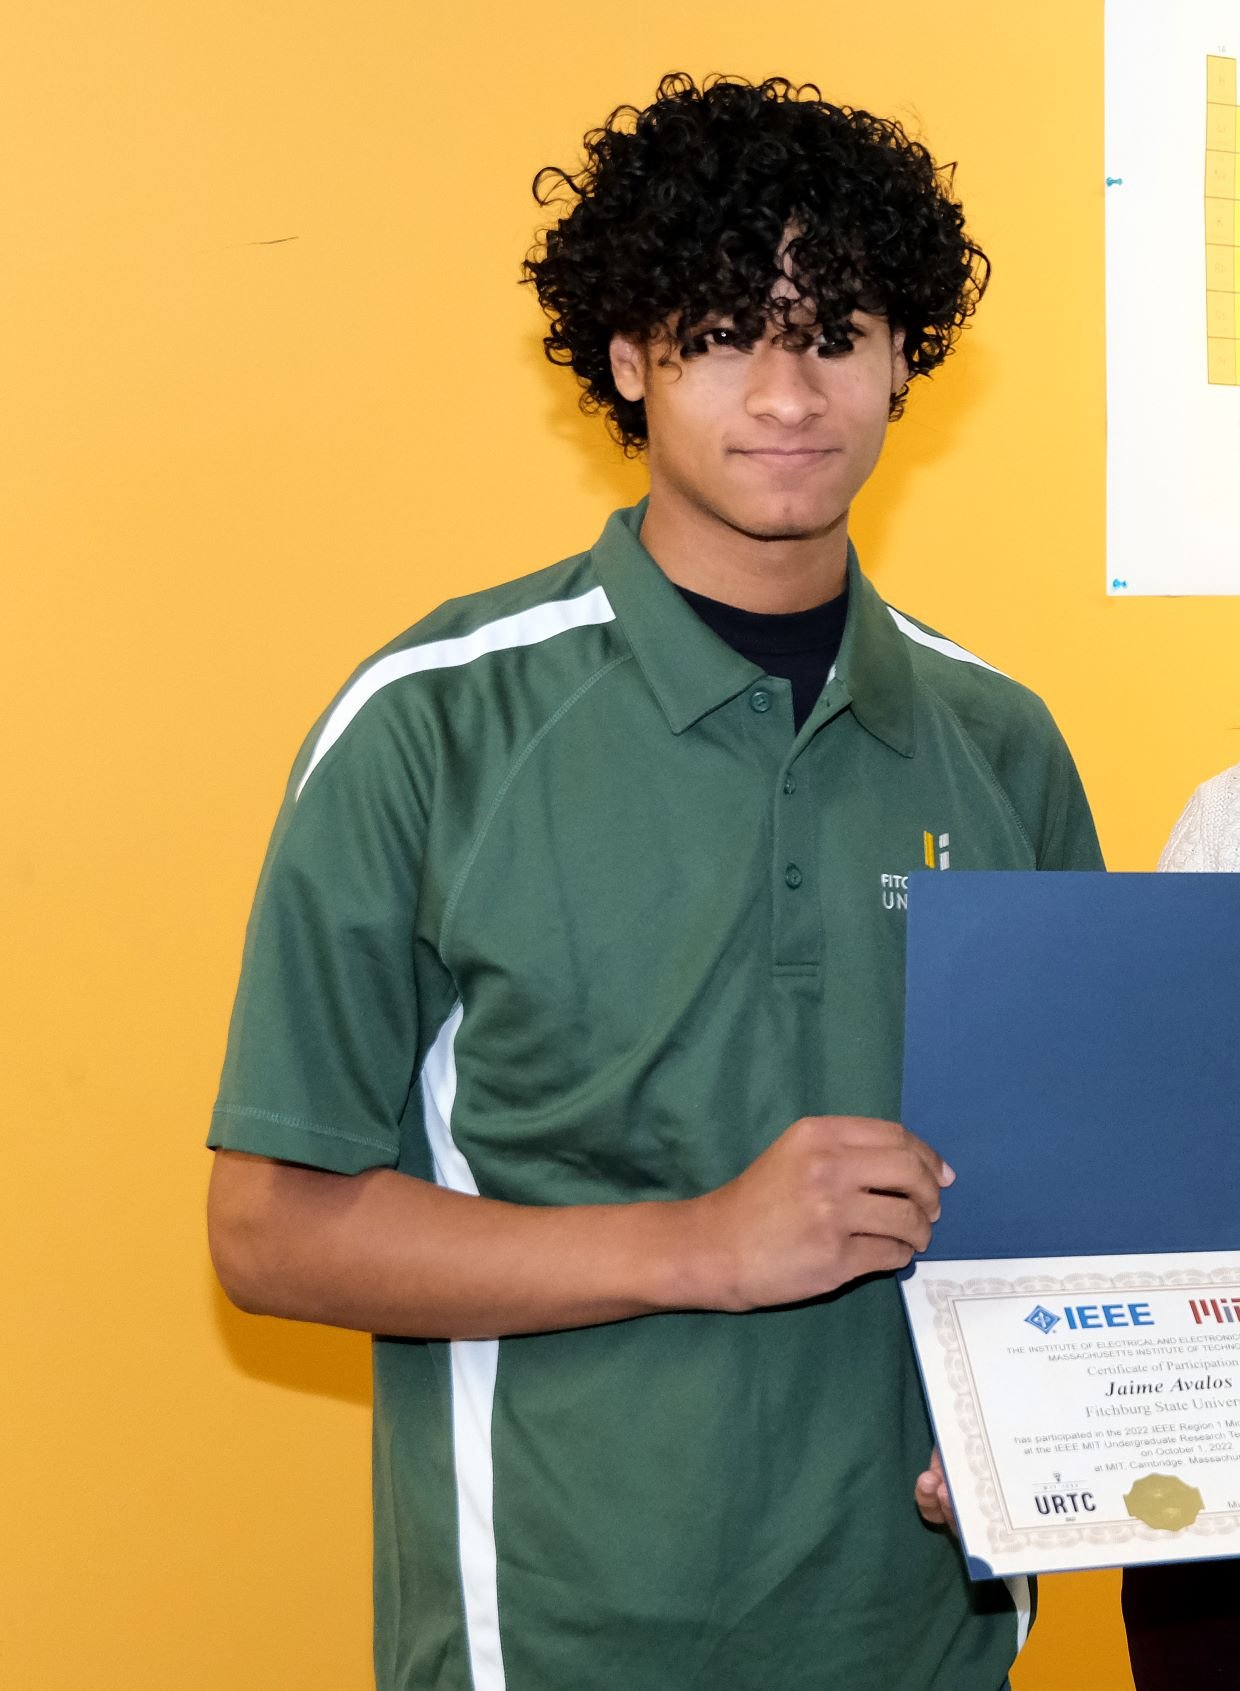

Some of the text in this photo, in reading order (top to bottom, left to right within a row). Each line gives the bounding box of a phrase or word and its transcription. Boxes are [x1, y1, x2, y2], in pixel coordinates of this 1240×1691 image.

[1064, 1303, 1155, 1330] IEEE
[1007, 1346, 1024, 1354] THE
[1028, 1343, 1076, 1353] INSTITUTE
[1096, 1339, 1153, 1349] ELECTRICAL
[1156, 1337, 1177, 1345] AND
[1048, 1349, 1133, 1361] MASSACHUSETTS
[1136, 1346, 1184, 1356] INSTITUTE
[1087, 1358, 1239, 1376] Certificate of Participation
[1106, 1376, 1232, 1396] Jaime Avalos
[1086, 1403, 1151, 1417] Fitchburg
[1155, 1401, 1189, 1412] State
[1035, 1430, 1092, 1443] participated
[1106, 1428, 1122, 1436] the
[1125, 1426, 1148, 1435] 2022
[1151, 1424, 1176, 1433] IEEE
[1179, 1422, 1214, 1431] Region
[1217, 1420, 1221, 1428] 1
[1035, 1445, 1051, 1453] the
[1054, 1443, 1078, 1452] IEEE
[1082, 1441, 1100, 1450] MIT
[1104, 1436, 1176, 1448] Undergraduate
[1179, 1432, 1226, 1442] Research
[1155, 1446, 1194, 1455] October
[1209, 1442, 1232, 1451] 2022
[1034, 1492, 1096, 1514] URTC
